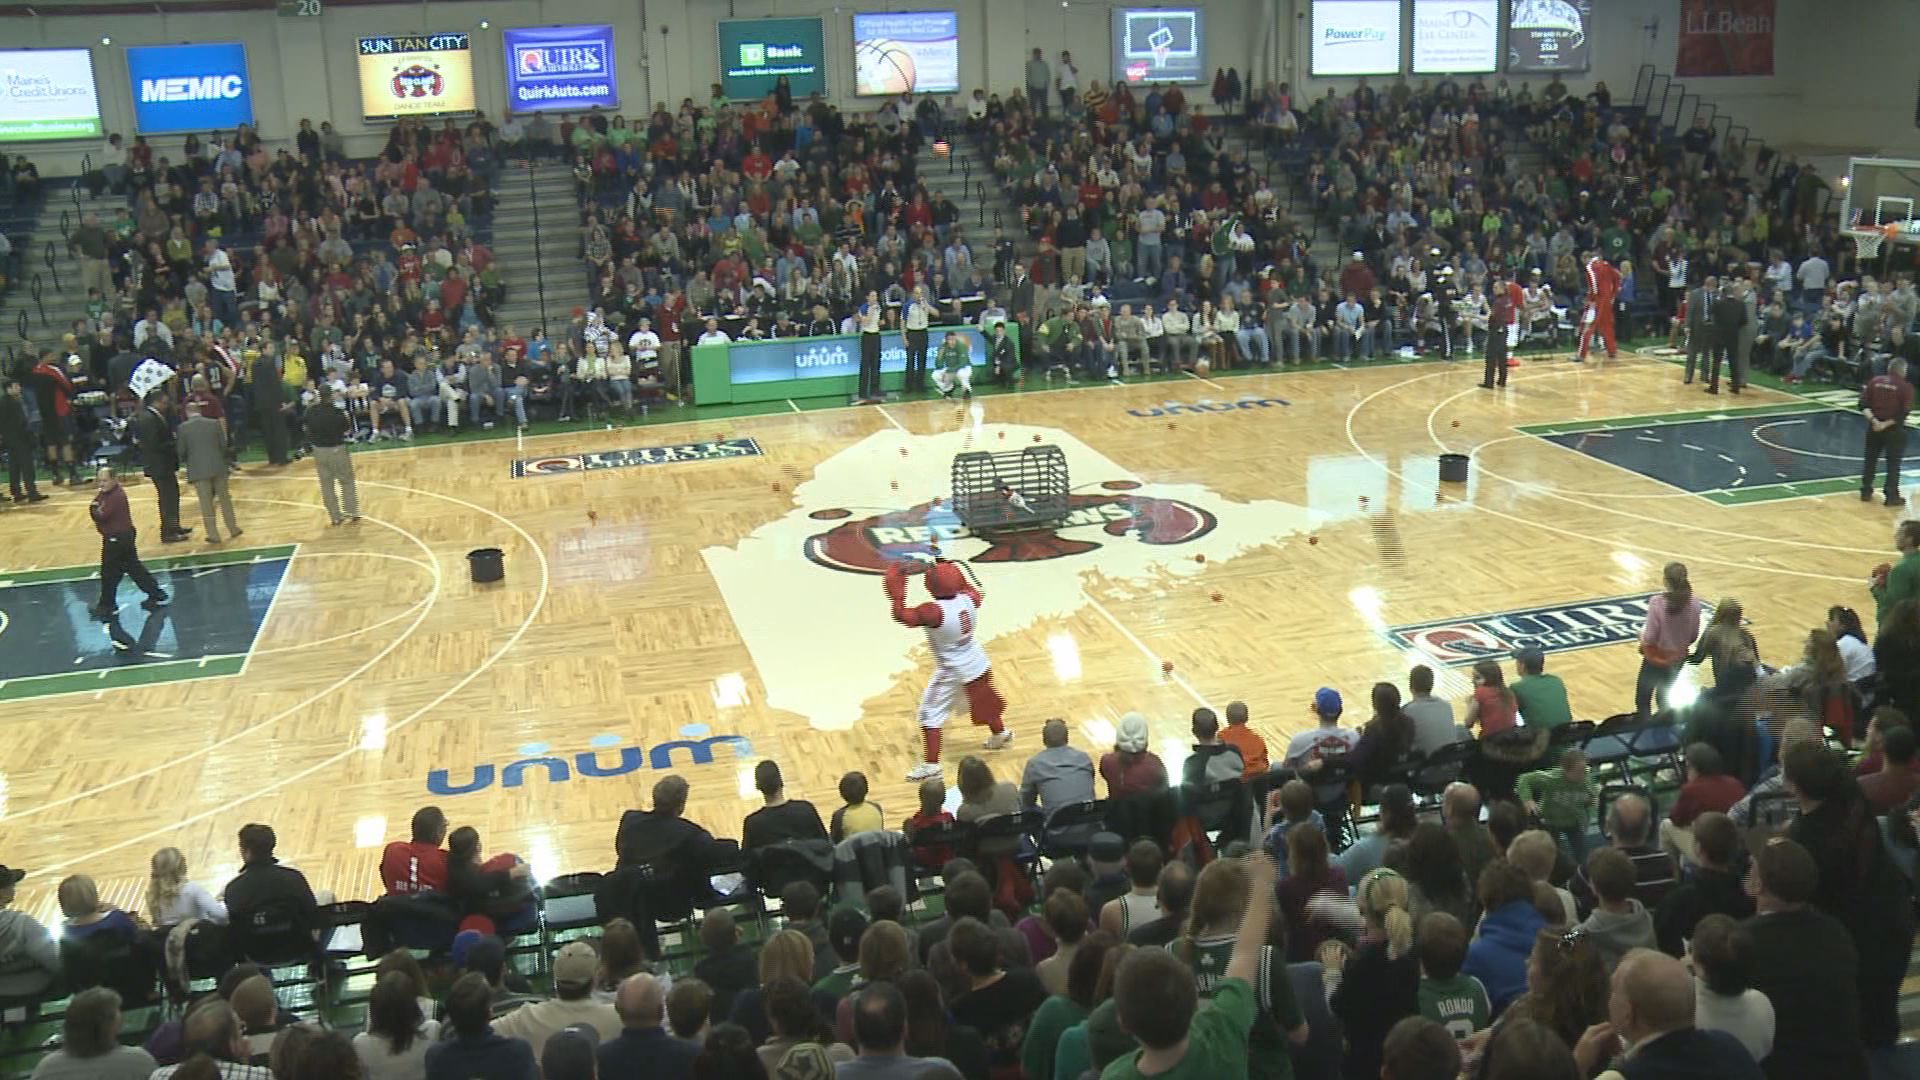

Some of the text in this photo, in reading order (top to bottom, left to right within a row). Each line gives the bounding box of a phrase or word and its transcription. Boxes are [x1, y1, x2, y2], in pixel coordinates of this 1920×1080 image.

[1325, 28, 1386, 41] PowerPay
[361, 36, 464, 54] SUN TAN CITY
[767, 45, 802, 57] Bank
[521, 48, 600, 72] QUIRK
[141, 75, 242, 102] MEMIC
[519, 85, 608, 100] QuirkAuto.com
[527, 443, 748, 473] QUIRK
[427, 724, 753, 795] unum
[1438, 998, 1474, 1018] RONDO
